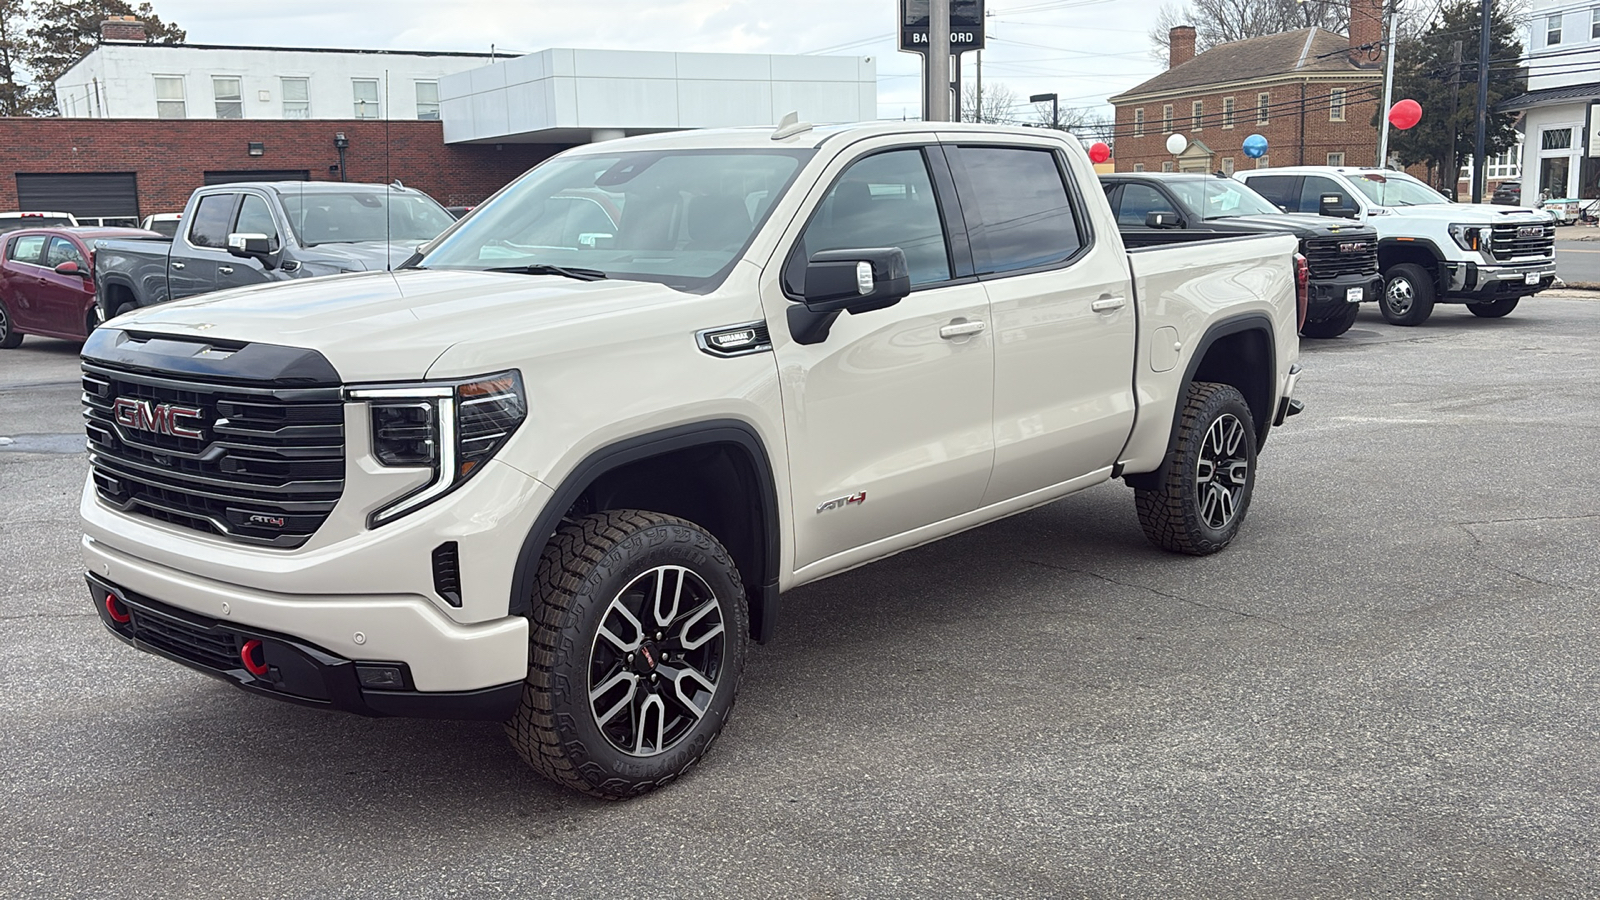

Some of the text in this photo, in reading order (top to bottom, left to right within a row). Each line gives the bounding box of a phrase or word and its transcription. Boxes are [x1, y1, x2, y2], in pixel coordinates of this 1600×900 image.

[913, 32, 973, 43] BAORD
[718, 332, 749, 343] DURAMAX
[114, 397, 204, 440] GMC
[816, 490, 867, 514] AT4
[249, 515, 284, 527] AT4
